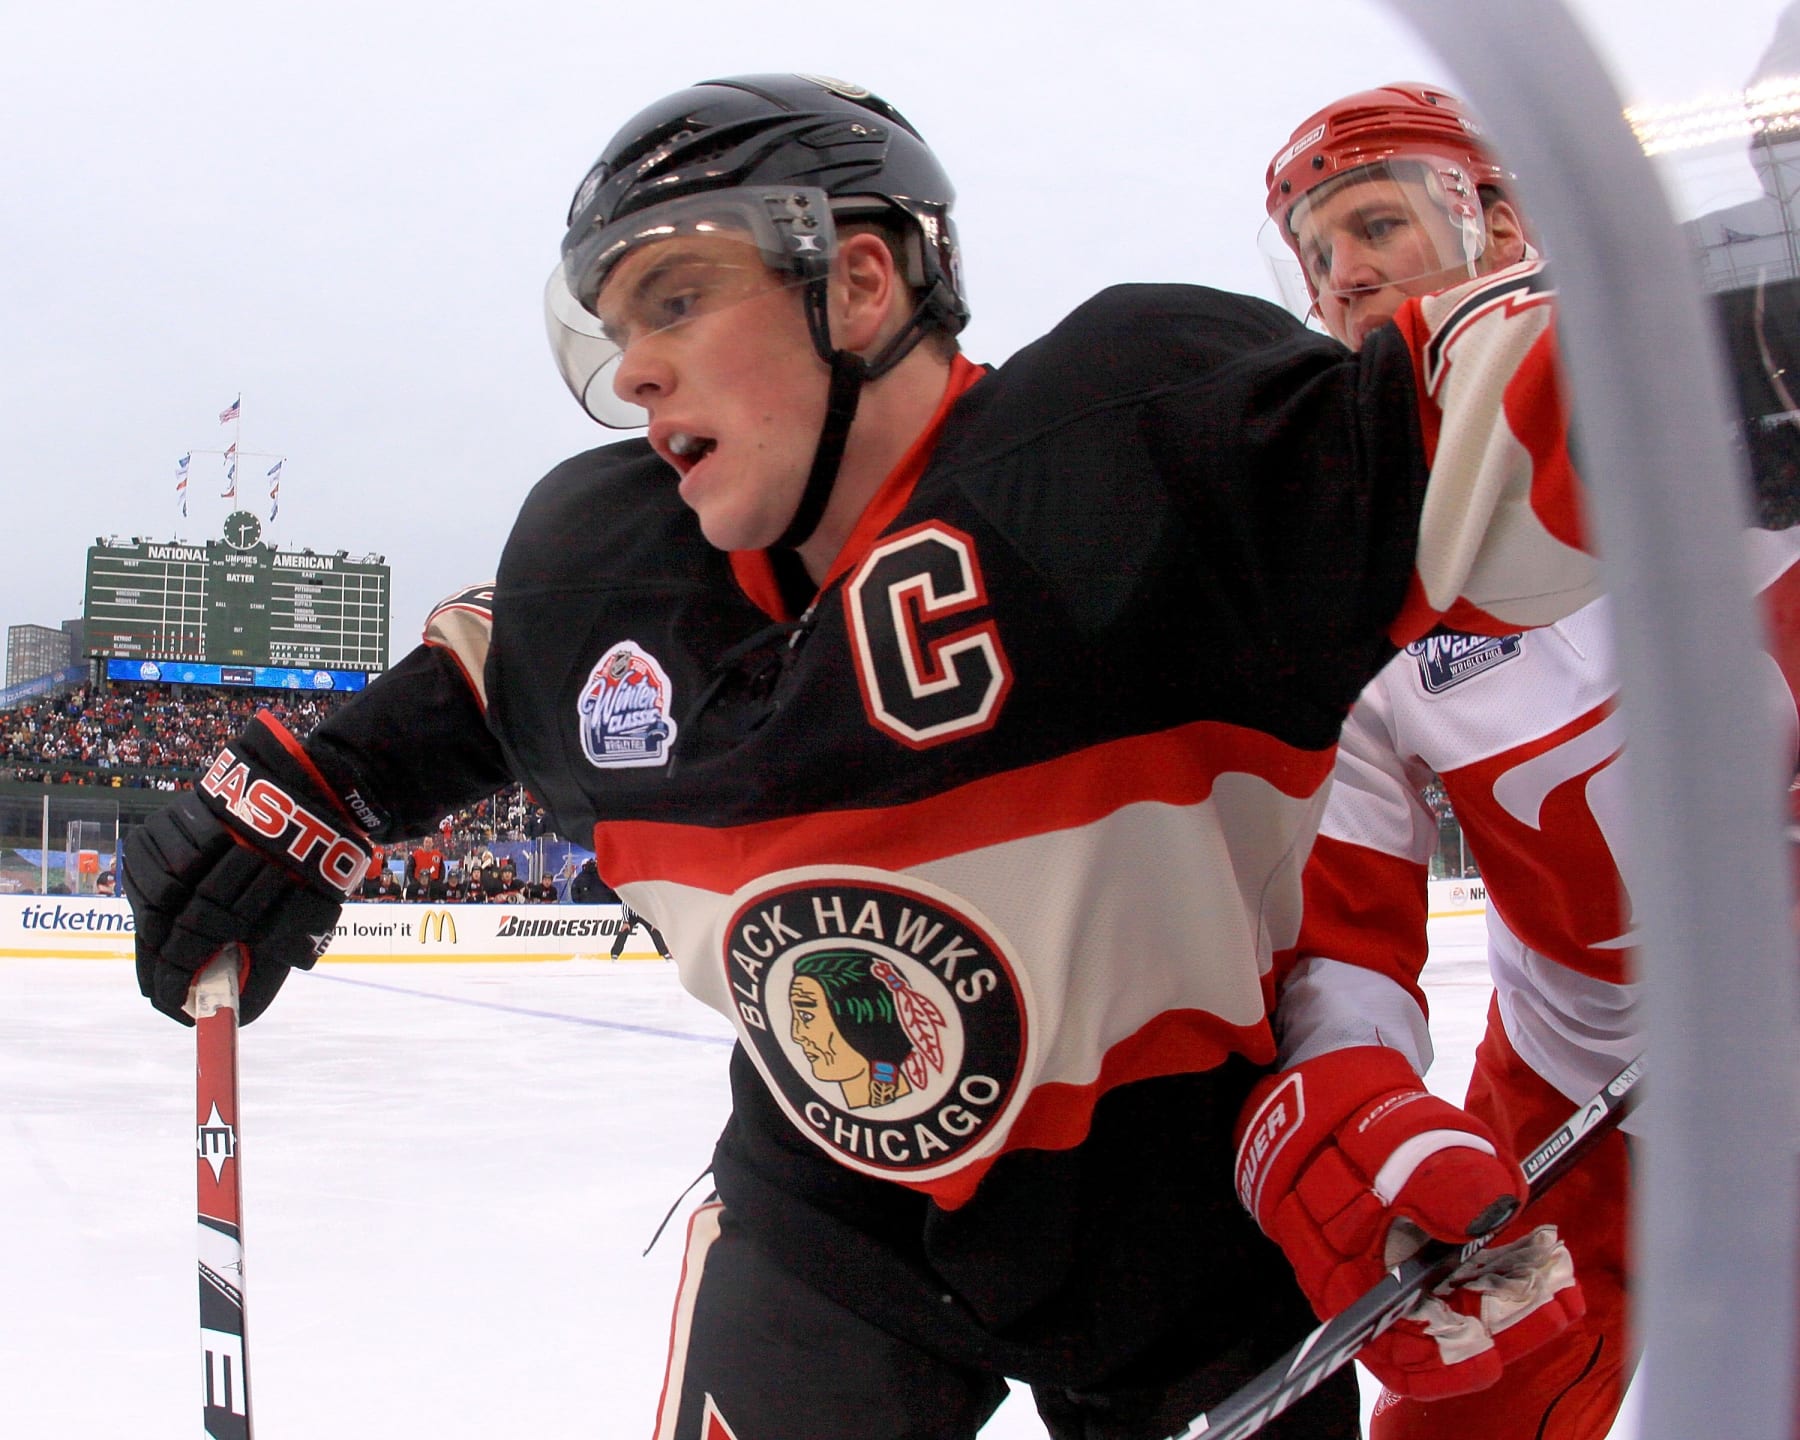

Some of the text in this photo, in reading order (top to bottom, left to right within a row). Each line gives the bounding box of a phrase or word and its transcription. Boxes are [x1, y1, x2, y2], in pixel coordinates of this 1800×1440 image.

[148, 546, 210, 561] NATIONAL
[225, 554, 258, 564] UMPIRES
[272, 554, 334, 570] AMERICAN
[226, 573, 255, 583] BATTER
[269, 643, 298, 651] HAPPY
[841, 518, 1015, 751] C
[1450, 653, 1484, 676] WRIGLEY
[607, 707, 662, 734] CLASSIC
[345, 788, 381, 828] TOEWS
[200, 748, 371, 896] EASTO
[22, 904, 136, 932] ticketma
[353, 922, 398, 937] lovin'
[401, 923, 412, 937] it
[732, 896, 998, 1031] BLACK HAWKS
[803, 1074, 1000, 1162] CHICAGO
[1526, 1130, 1572, 1174] BAUER
